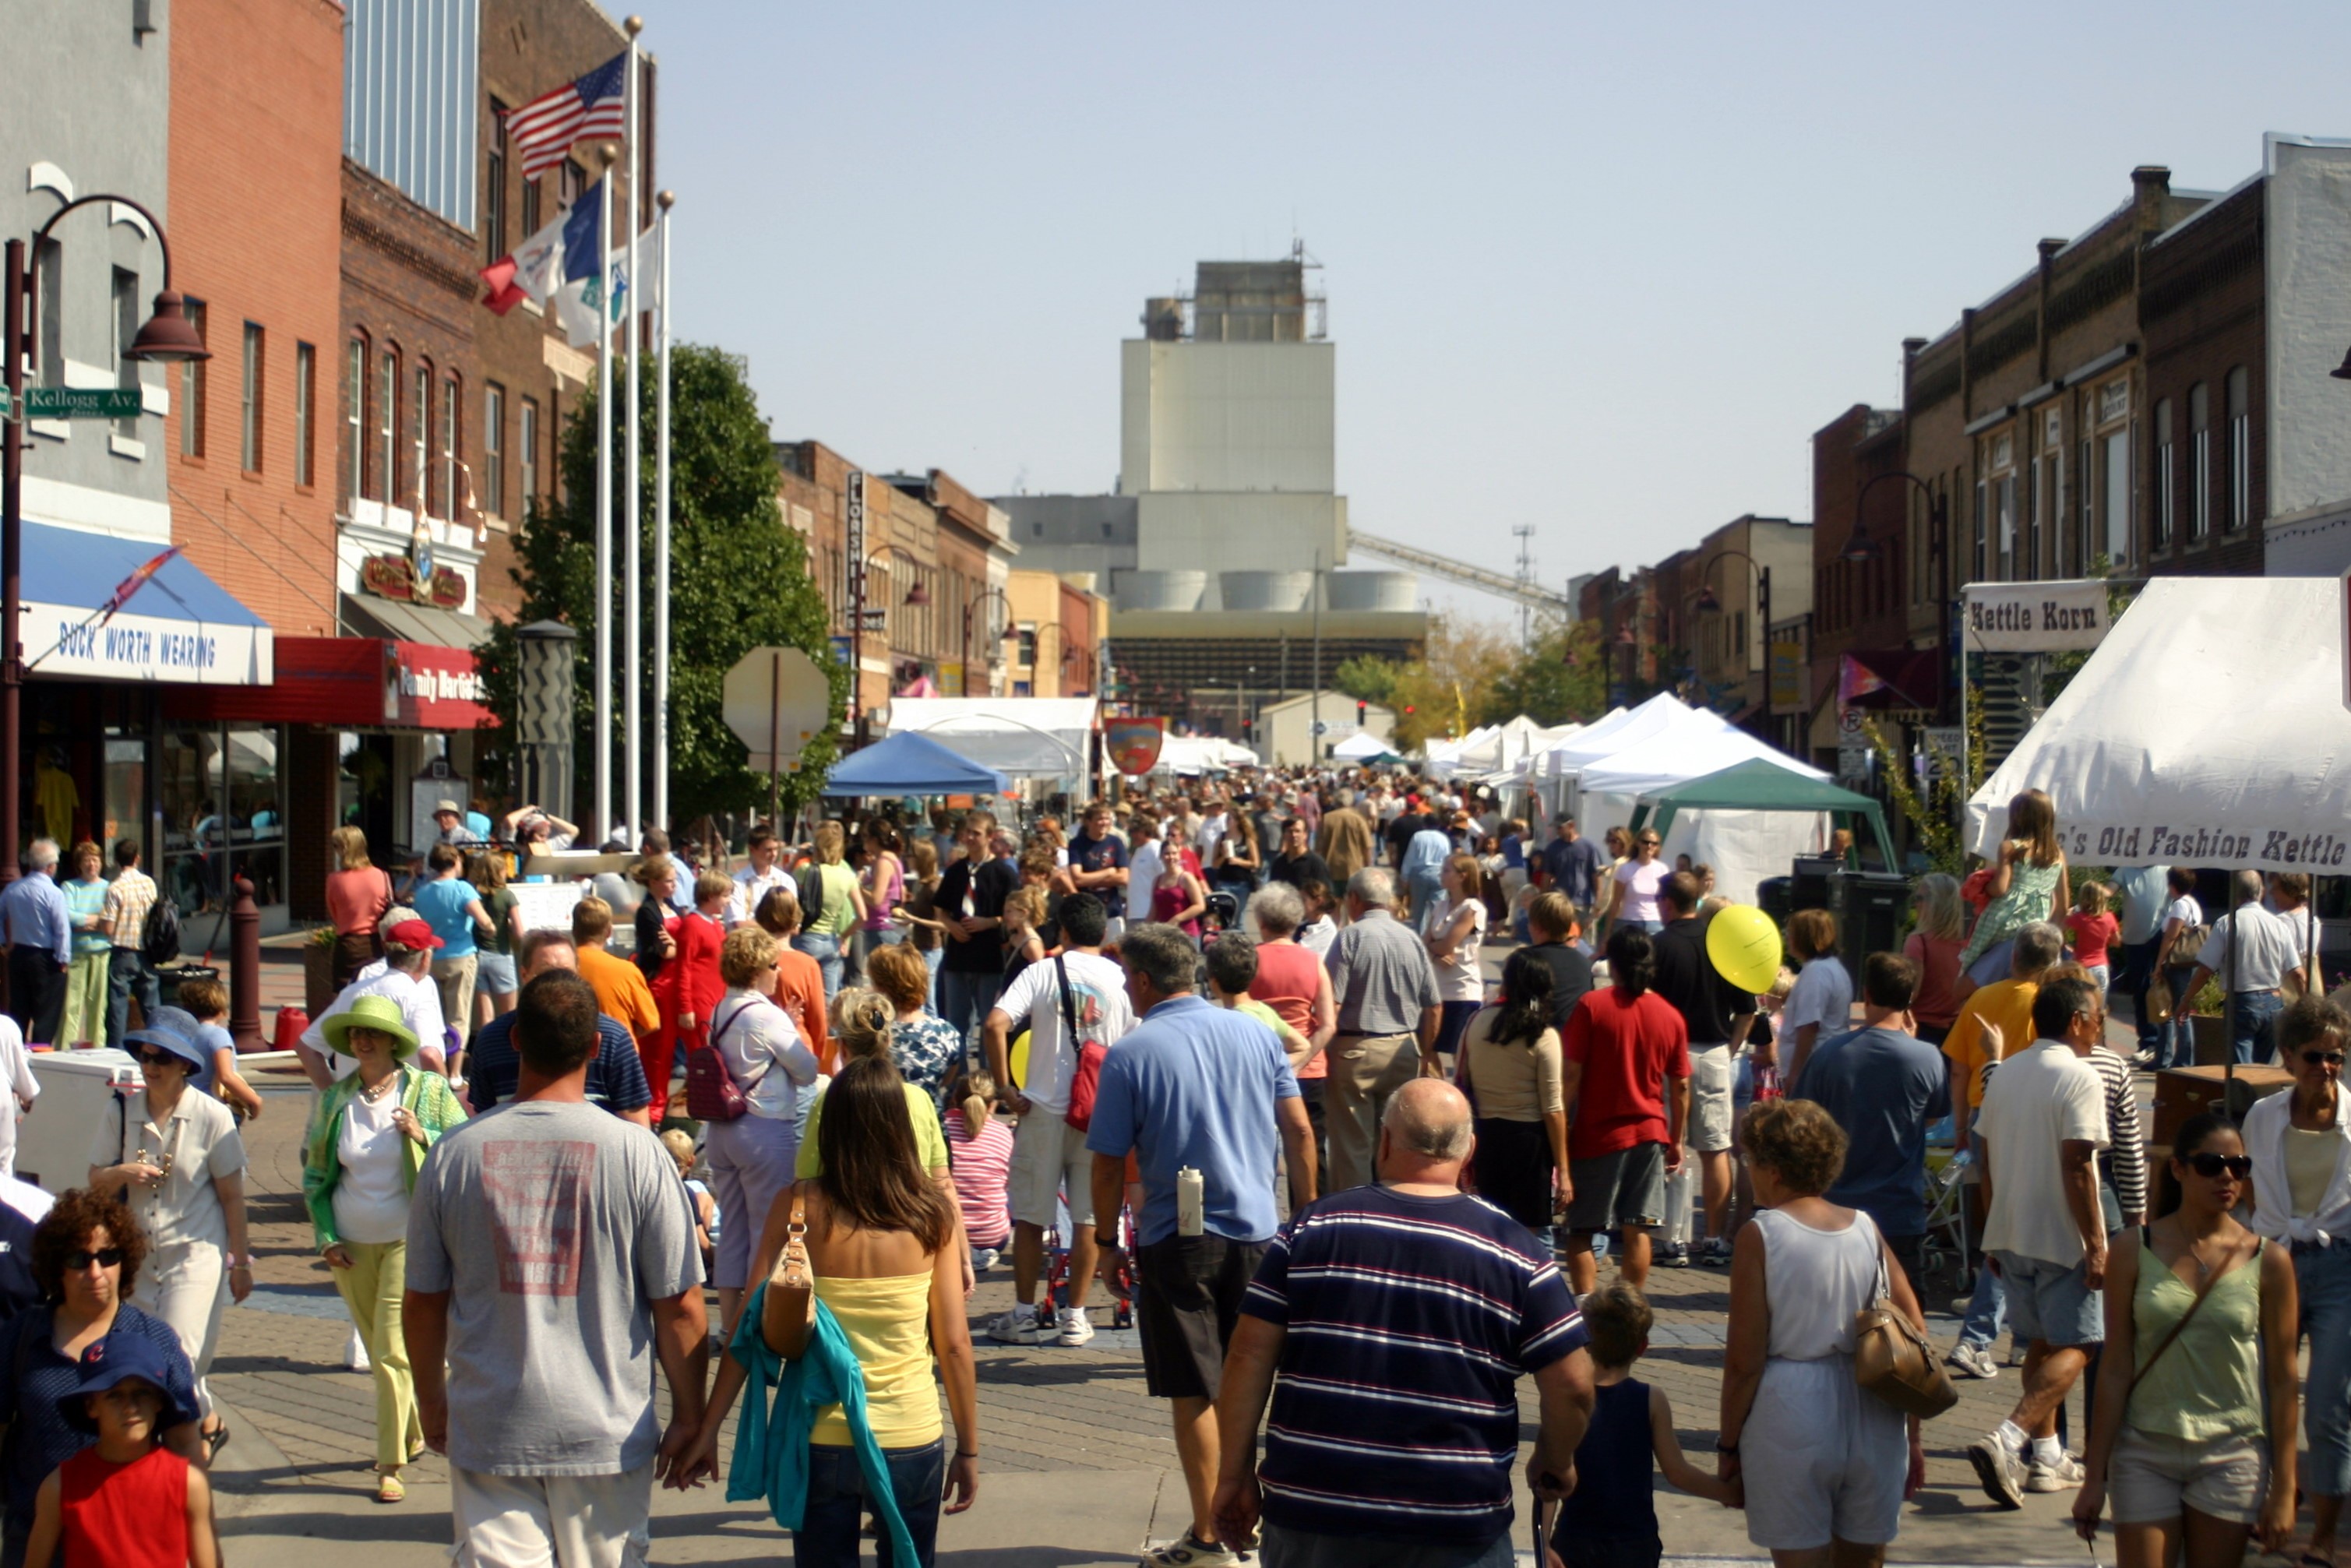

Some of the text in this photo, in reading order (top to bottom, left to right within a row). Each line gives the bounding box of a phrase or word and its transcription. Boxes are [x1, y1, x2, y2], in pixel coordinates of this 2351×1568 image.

[31, 391, 137, 408] Kellogg Av.
[1970, 601, 2097, 631] Kettle Korn
[59, 622, 216, 668] DUCK WORTH WEARING
[400, 664, 437, 704] Family
[439, 669, 474, 700] Martial
[2098, 826, 2141, 858] Old
[2148, 826, 2251, 859] Fashion
[2261, 830, 2346, 865] Kettle
